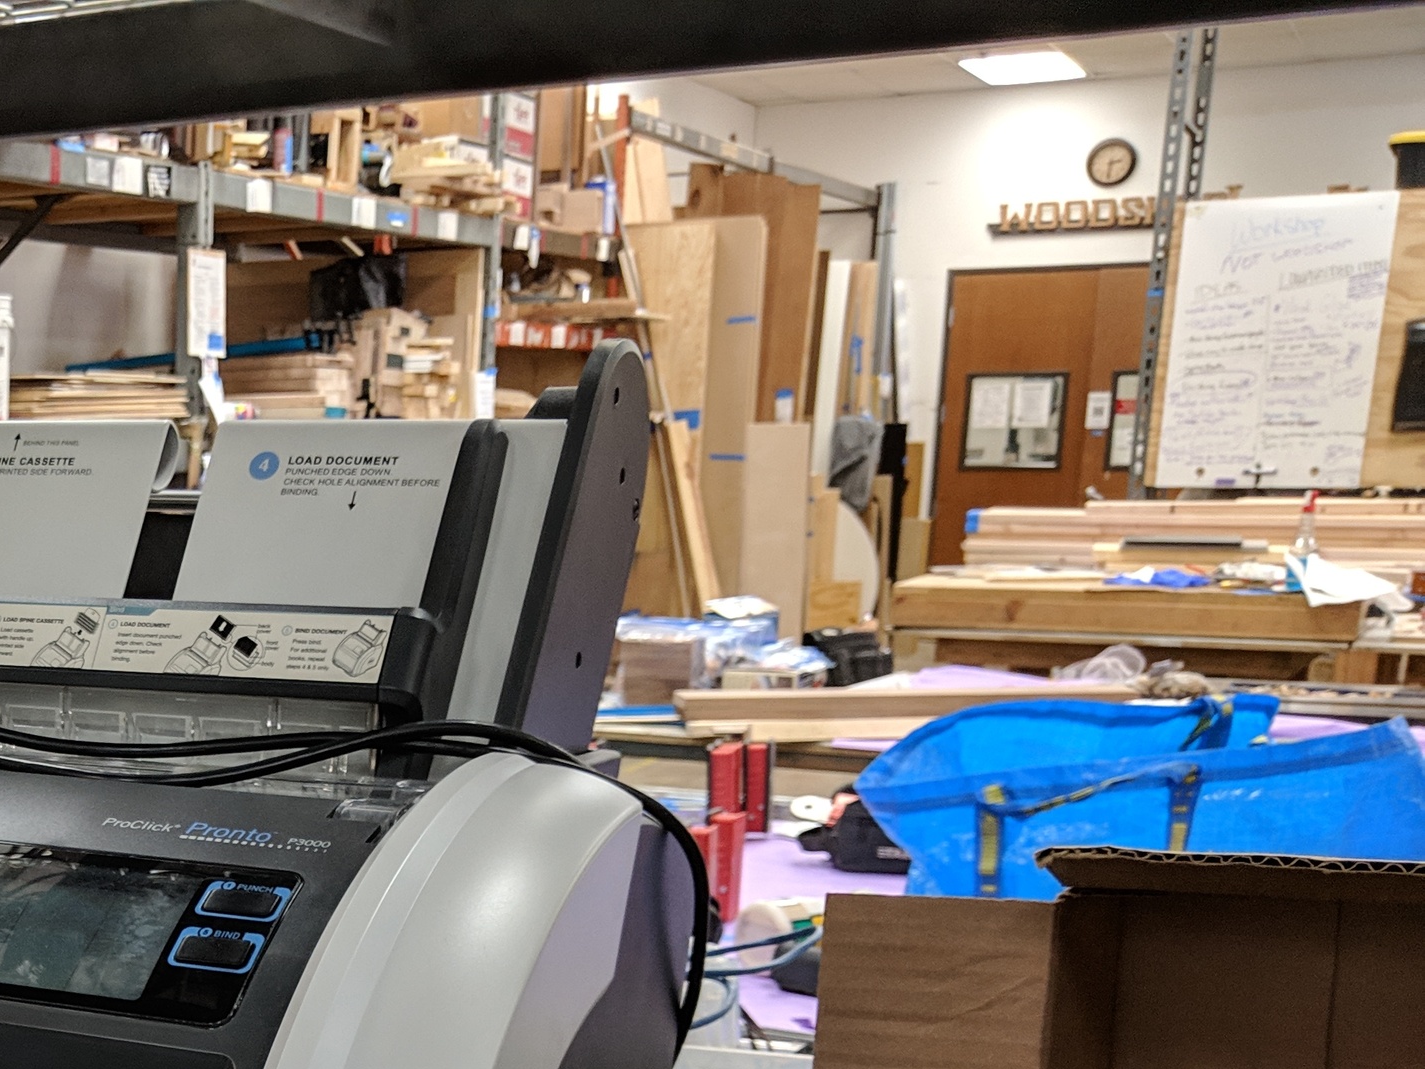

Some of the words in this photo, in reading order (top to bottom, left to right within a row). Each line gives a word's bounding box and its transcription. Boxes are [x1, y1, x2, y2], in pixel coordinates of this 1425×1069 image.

[20, 457, 76, 466] CASSETTE
[258, 458, 270, 472] 4
[288, 456, 322, 466] LOAD
[326, 456, 400, 466] DOCUMENT
[401, 479, 440, 487] BEFORE
[287, 838, 332, 849] P3000
[236, 884, 274, 893] PUNCH
[214, 930, 241, 940] BIND
